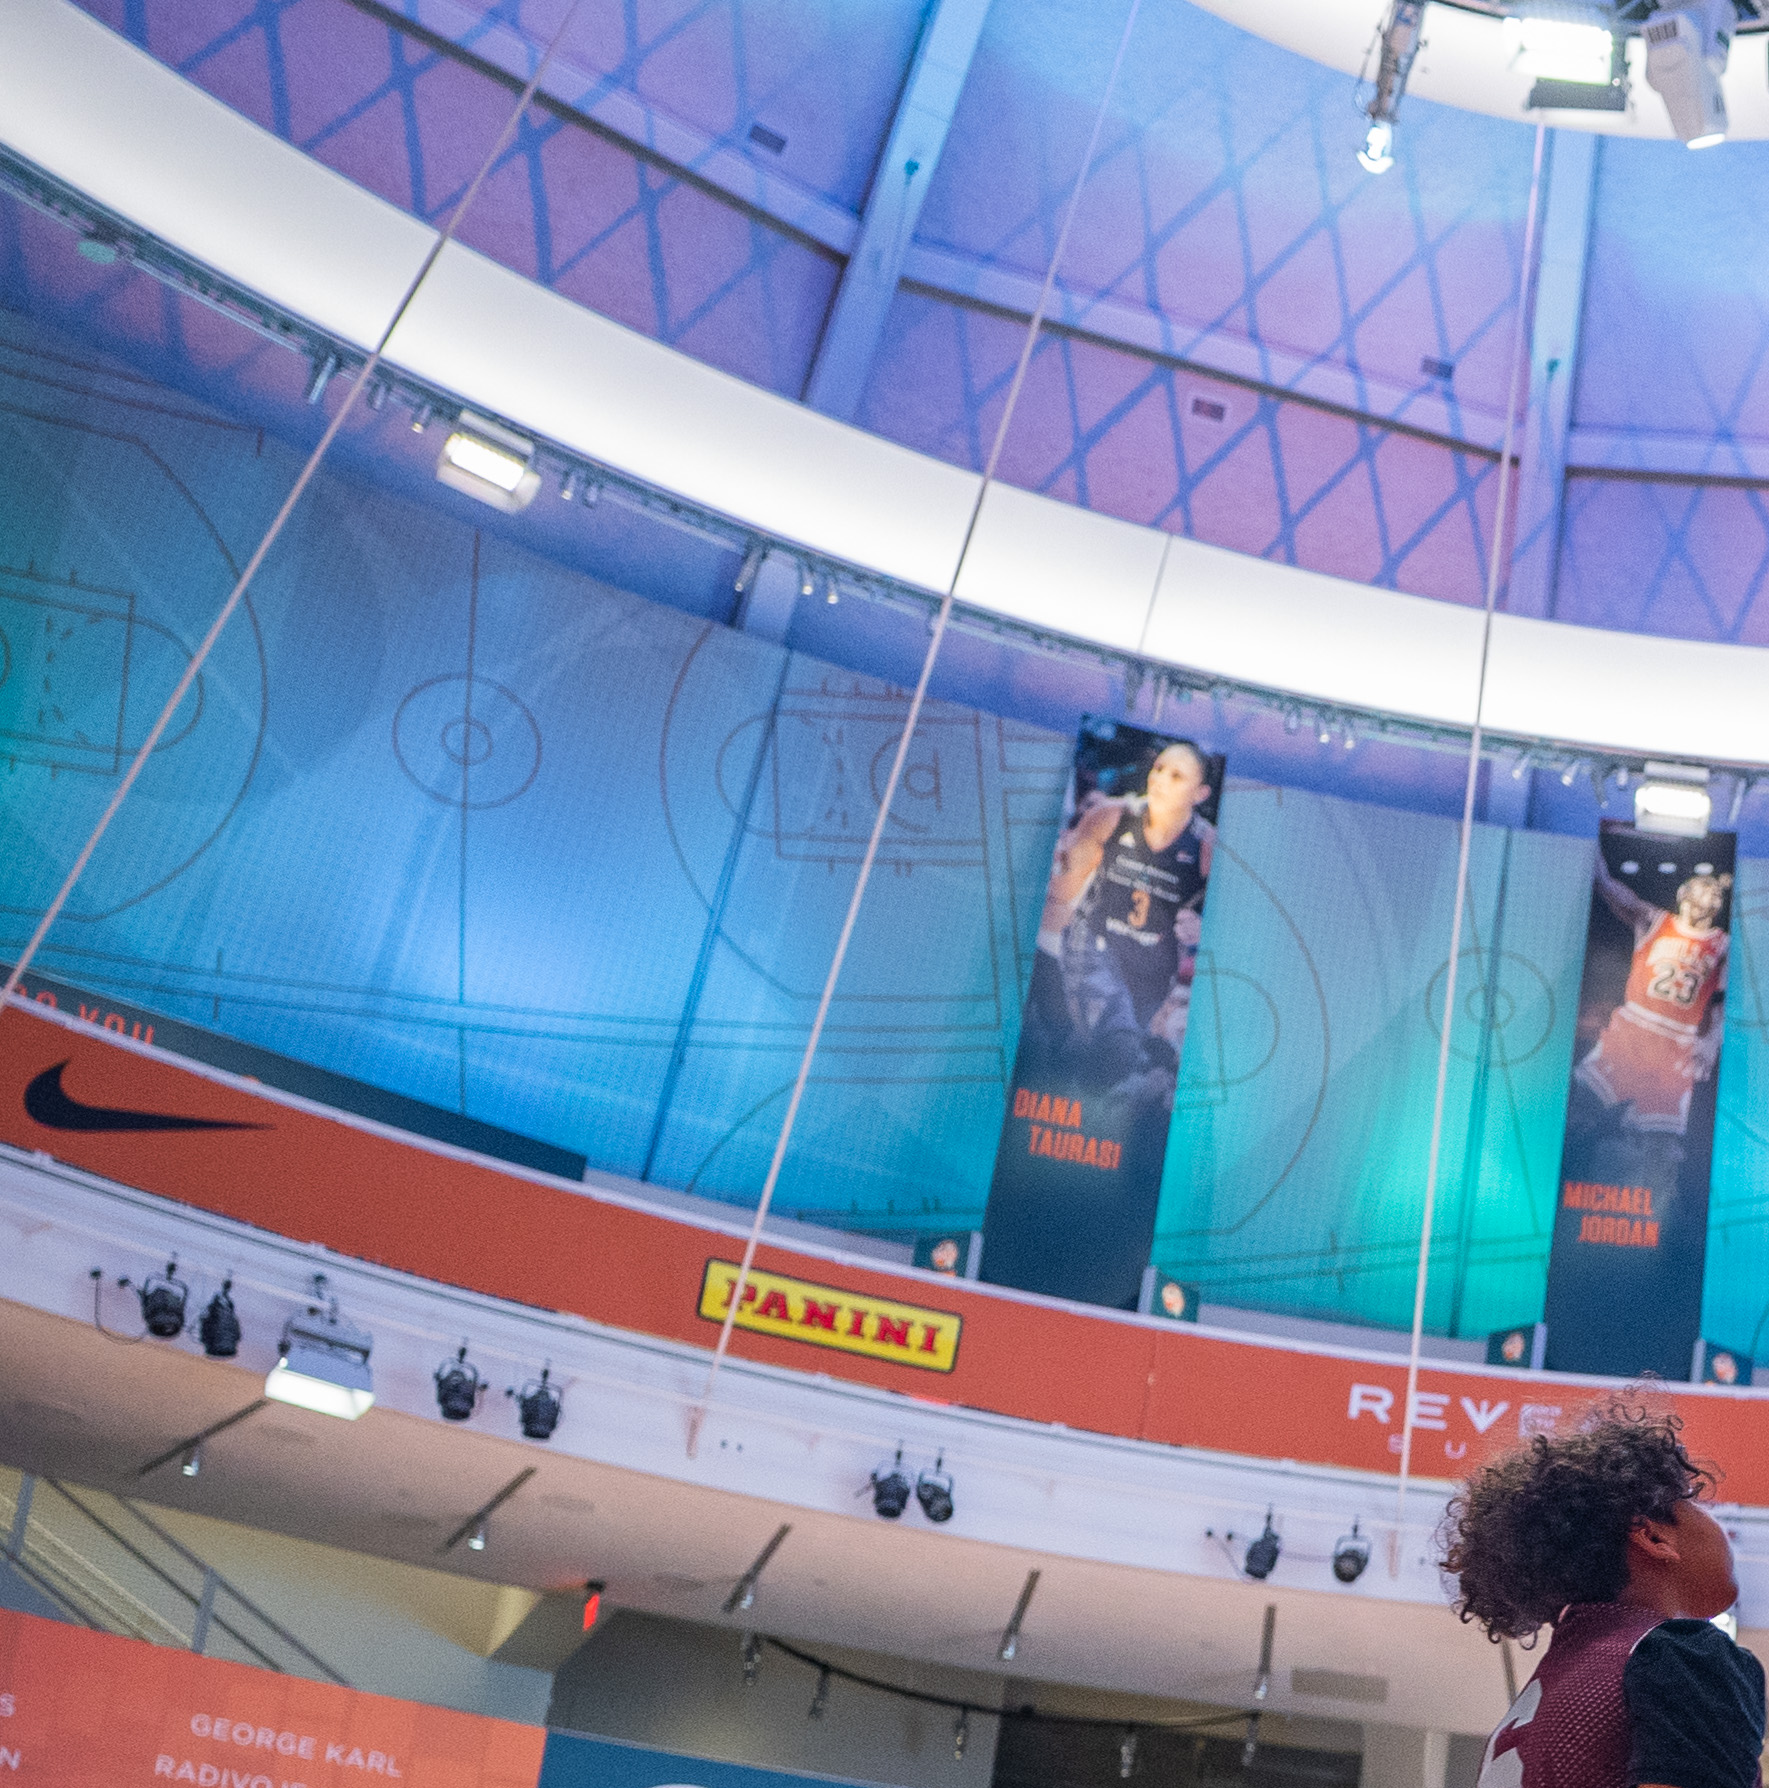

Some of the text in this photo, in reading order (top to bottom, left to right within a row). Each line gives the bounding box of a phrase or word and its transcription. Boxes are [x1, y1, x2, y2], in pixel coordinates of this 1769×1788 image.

[1128, 889, 1151, 929] 3
[1647, 966, 1702, 1009] 23
[1013, 1086, 1083, 1131] DIANA
[1028, 1124, 1122, 1172] TAURASI
[1563, 1180, 1654, 1217] MICHAEL
[1579, 1215, 1661, 1249] JORDAN
[722, 1278, 941, 1354] PANINI
[190, 1713, 402, 1778] GEORGE KARL
